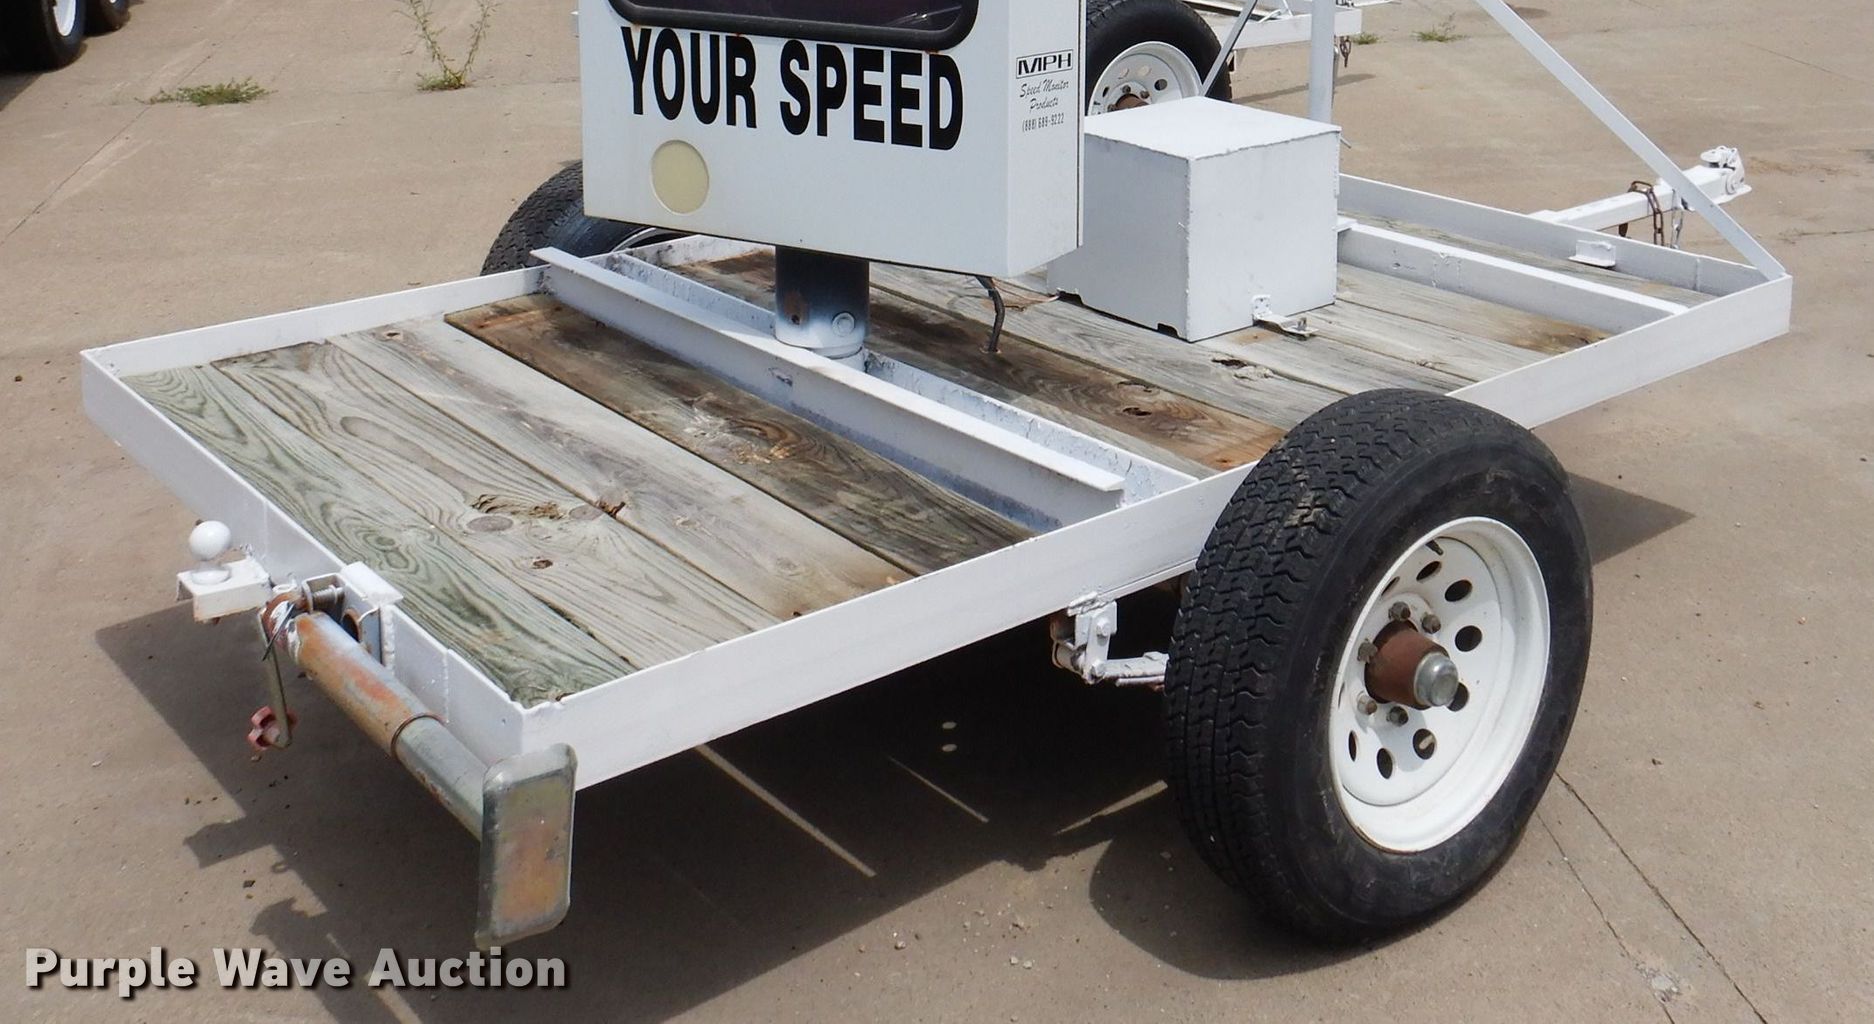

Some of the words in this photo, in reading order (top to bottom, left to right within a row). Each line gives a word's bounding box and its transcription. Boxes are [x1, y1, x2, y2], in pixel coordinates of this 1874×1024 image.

[1018, 52, 1072, 76] MPH
[621, 26, 757, 129] YOUR
[780, 39, 963, 151] SPEED
[1019, 82, 1041, 98] Speed
